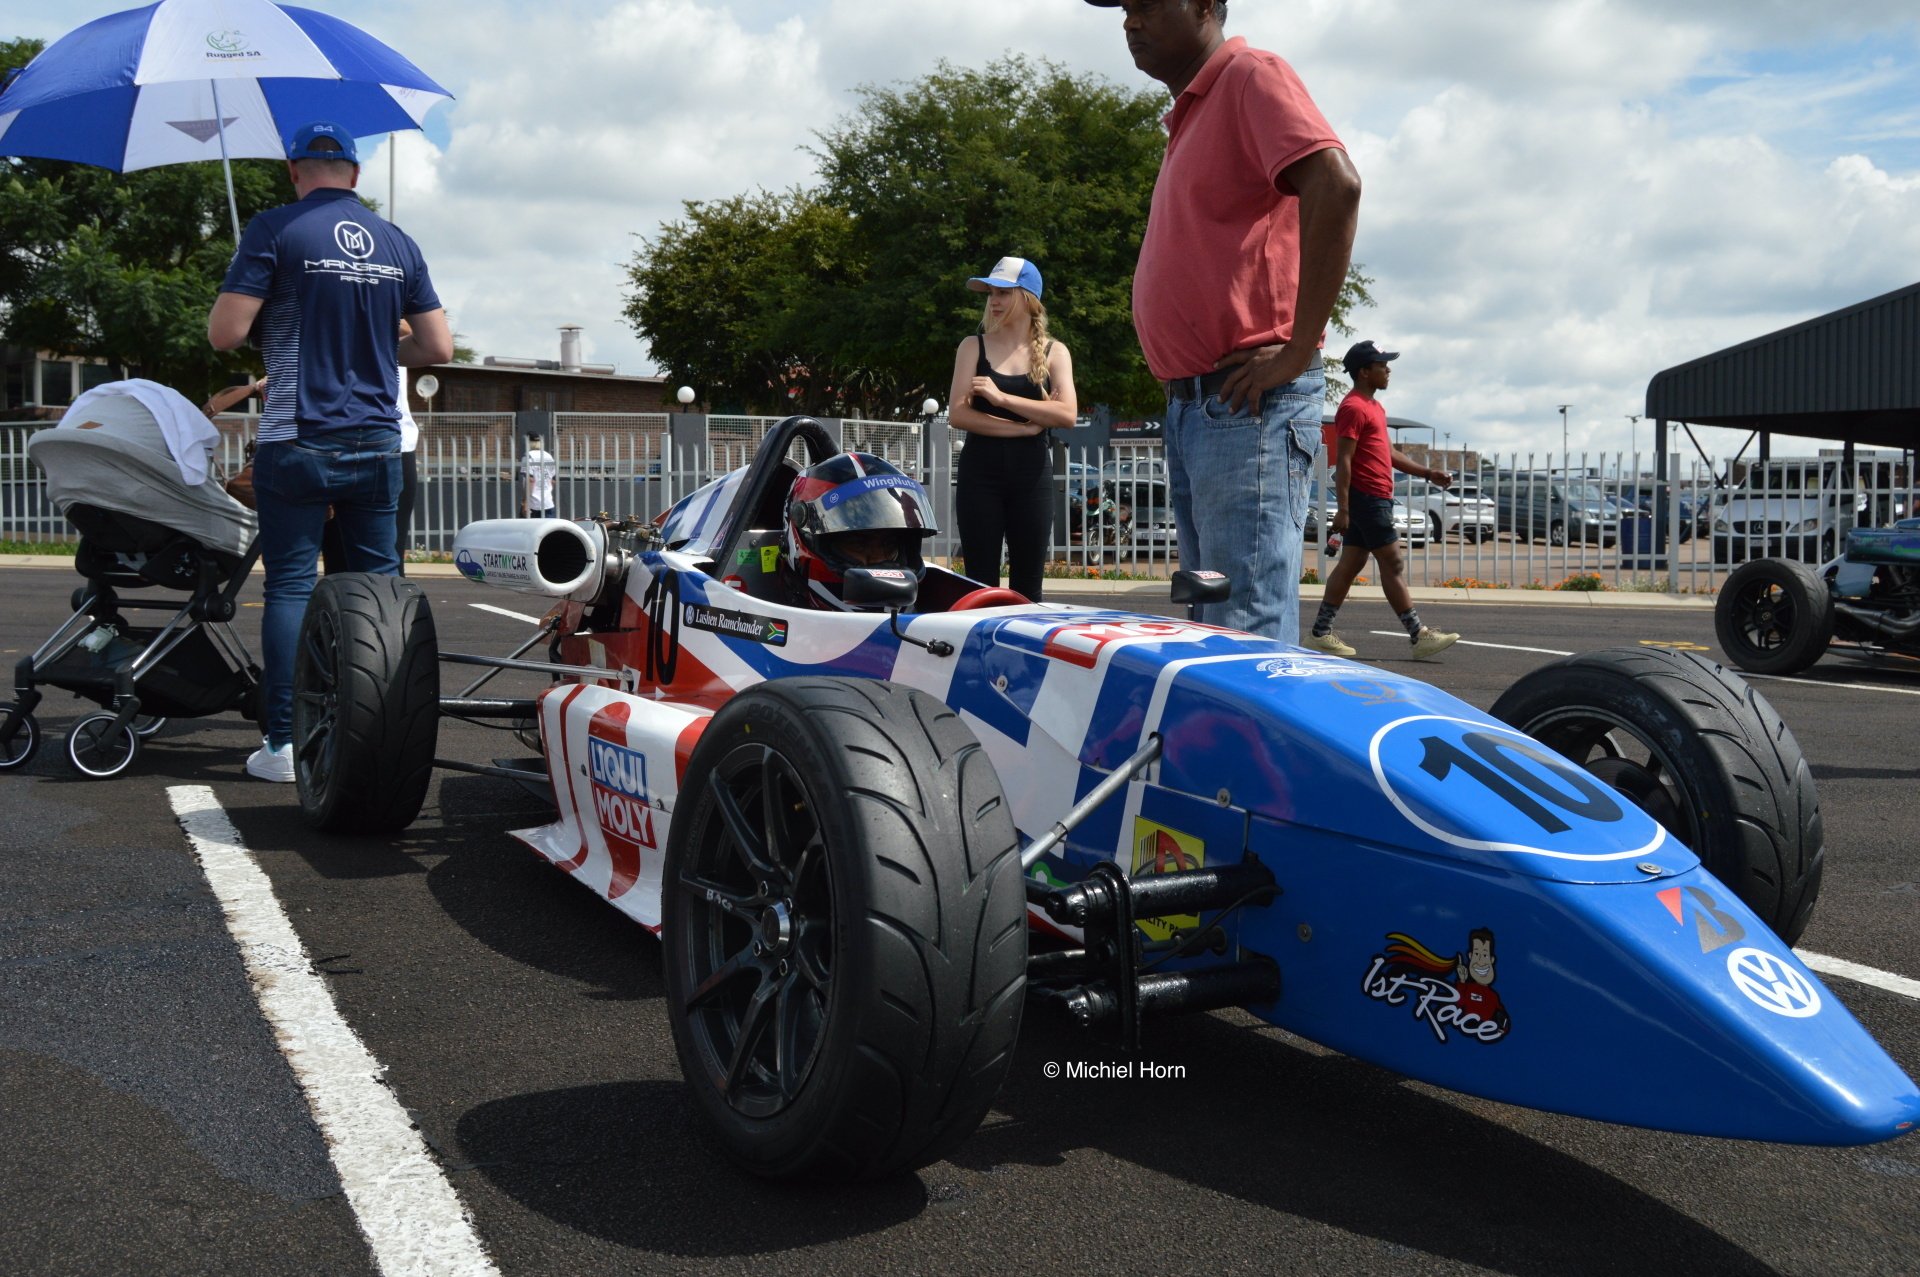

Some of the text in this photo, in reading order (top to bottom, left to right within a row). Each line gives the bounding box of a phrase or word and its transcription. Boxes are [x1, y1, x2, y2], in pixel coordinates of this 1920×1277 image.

[304, 259, 404, 278] MANGAZA
[863, 476, 916, 489] WingNuts
[483, 553, 528, 571] STARTMYCAR
[643, 568, 681, 685] 10
[718, 613, 764, 636] Ramchander
[590, 741, 645, 797] LIQUI
[1419, 732, 1623, 834] 10
[596, 788, 650, 843] MOLY
[1363, 957, 1505, 1041] 1st Race
